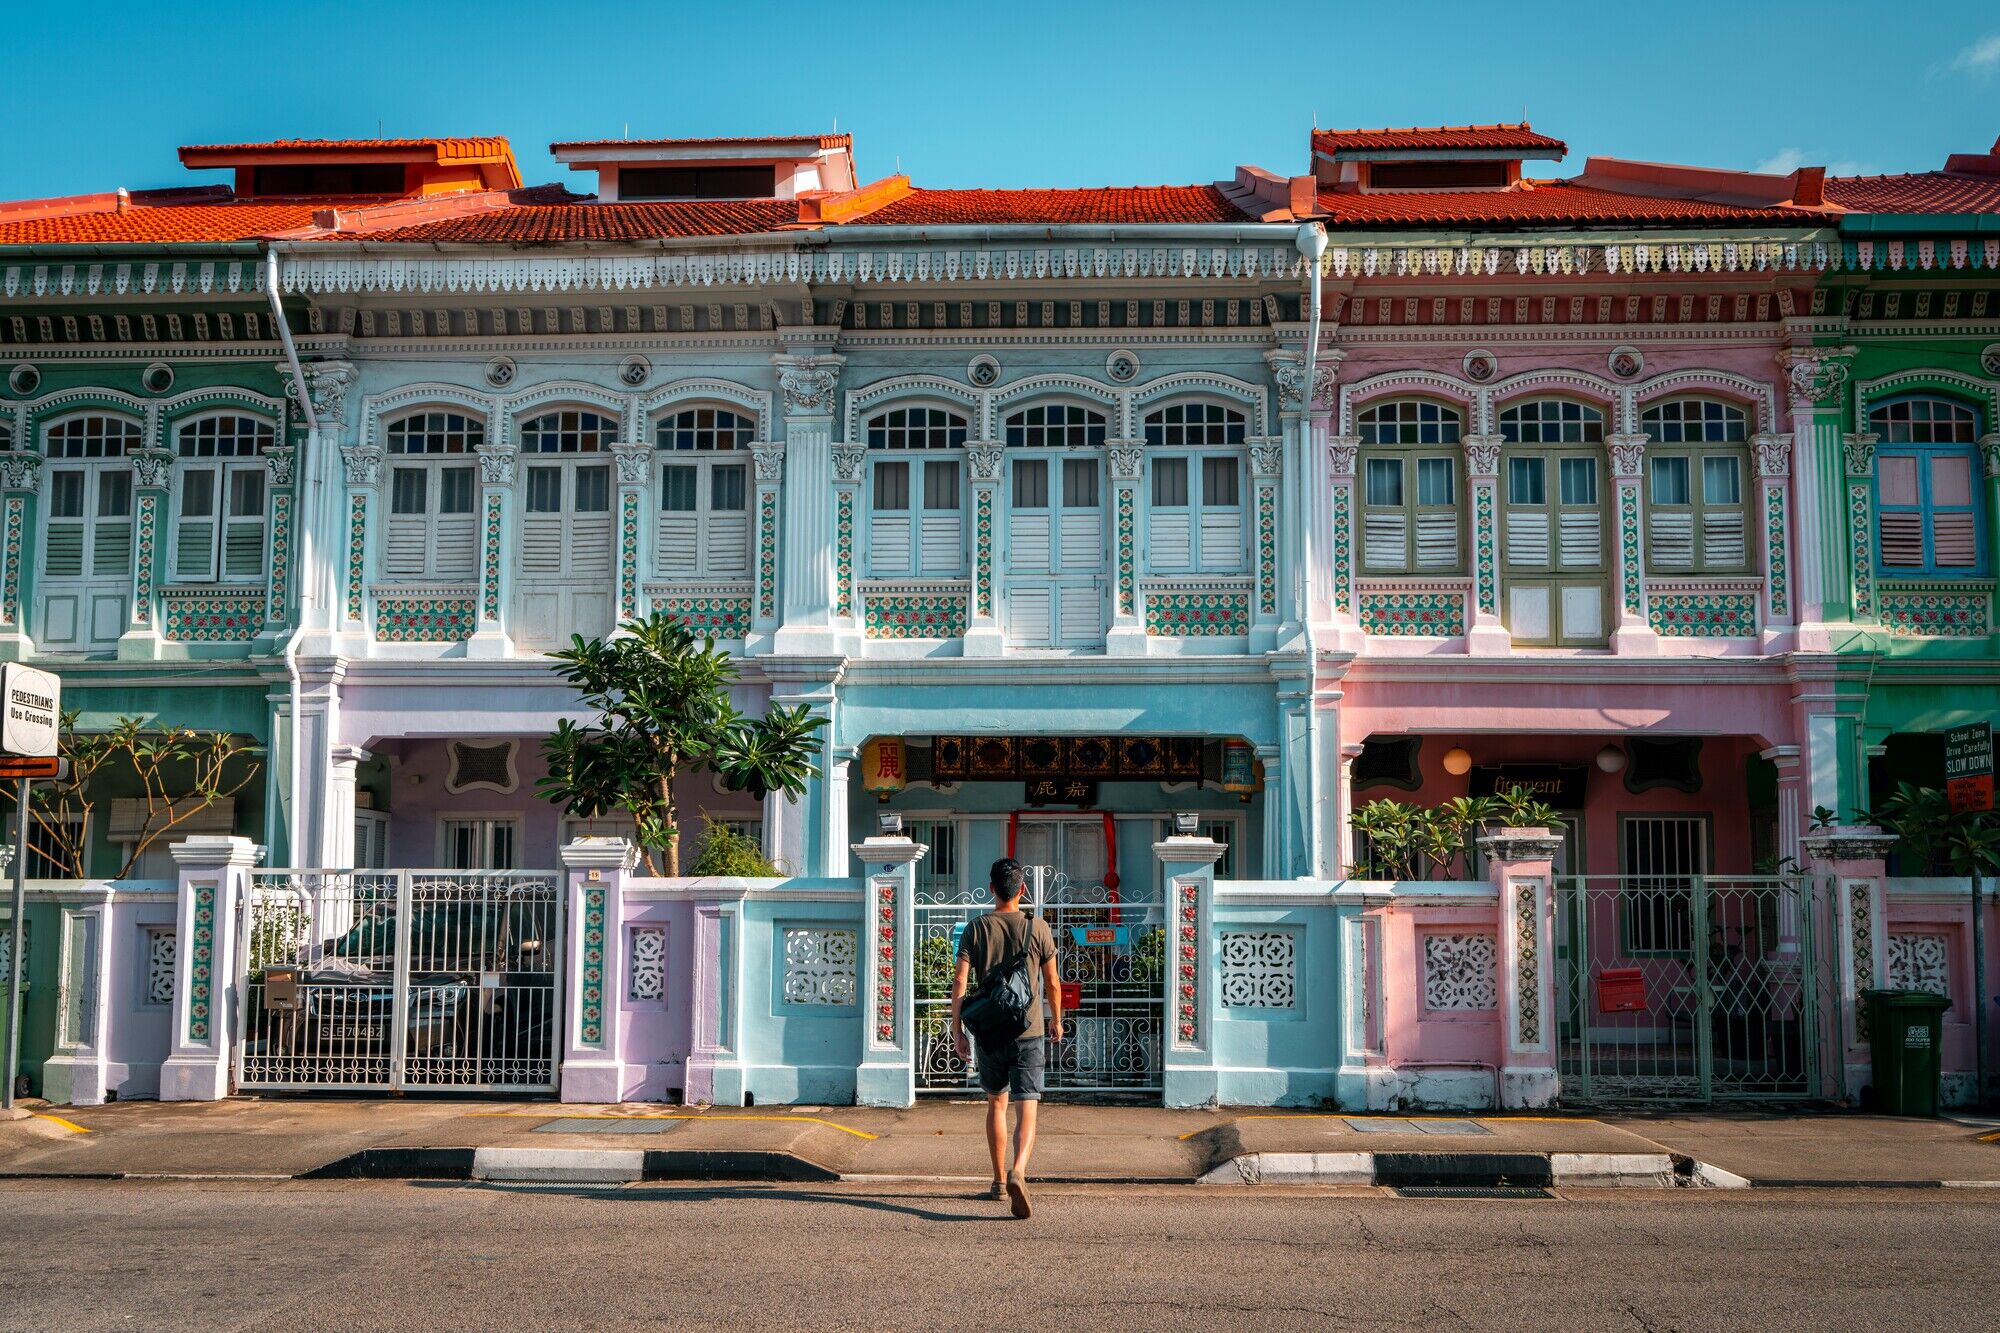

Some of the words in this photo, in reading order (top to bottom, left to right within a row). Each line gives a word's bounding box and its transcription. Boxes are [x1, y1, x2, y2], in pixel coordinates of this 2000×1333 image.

[11, 689, 54, 710] PEDESTRIANS
[10, 706, 23, 720] Use
[25, 710, 53, 728] Crossing
[1950, 731, 1970, 743] School
[1972, 728, 1986, 739] Zone
[1946, 746, 1961, 757] Drive
[1963, 741, 1991, 754] Carefully
[1946, 756, 1967, 773] SLOW
[1969, 753, 1992, 770] DOWN
